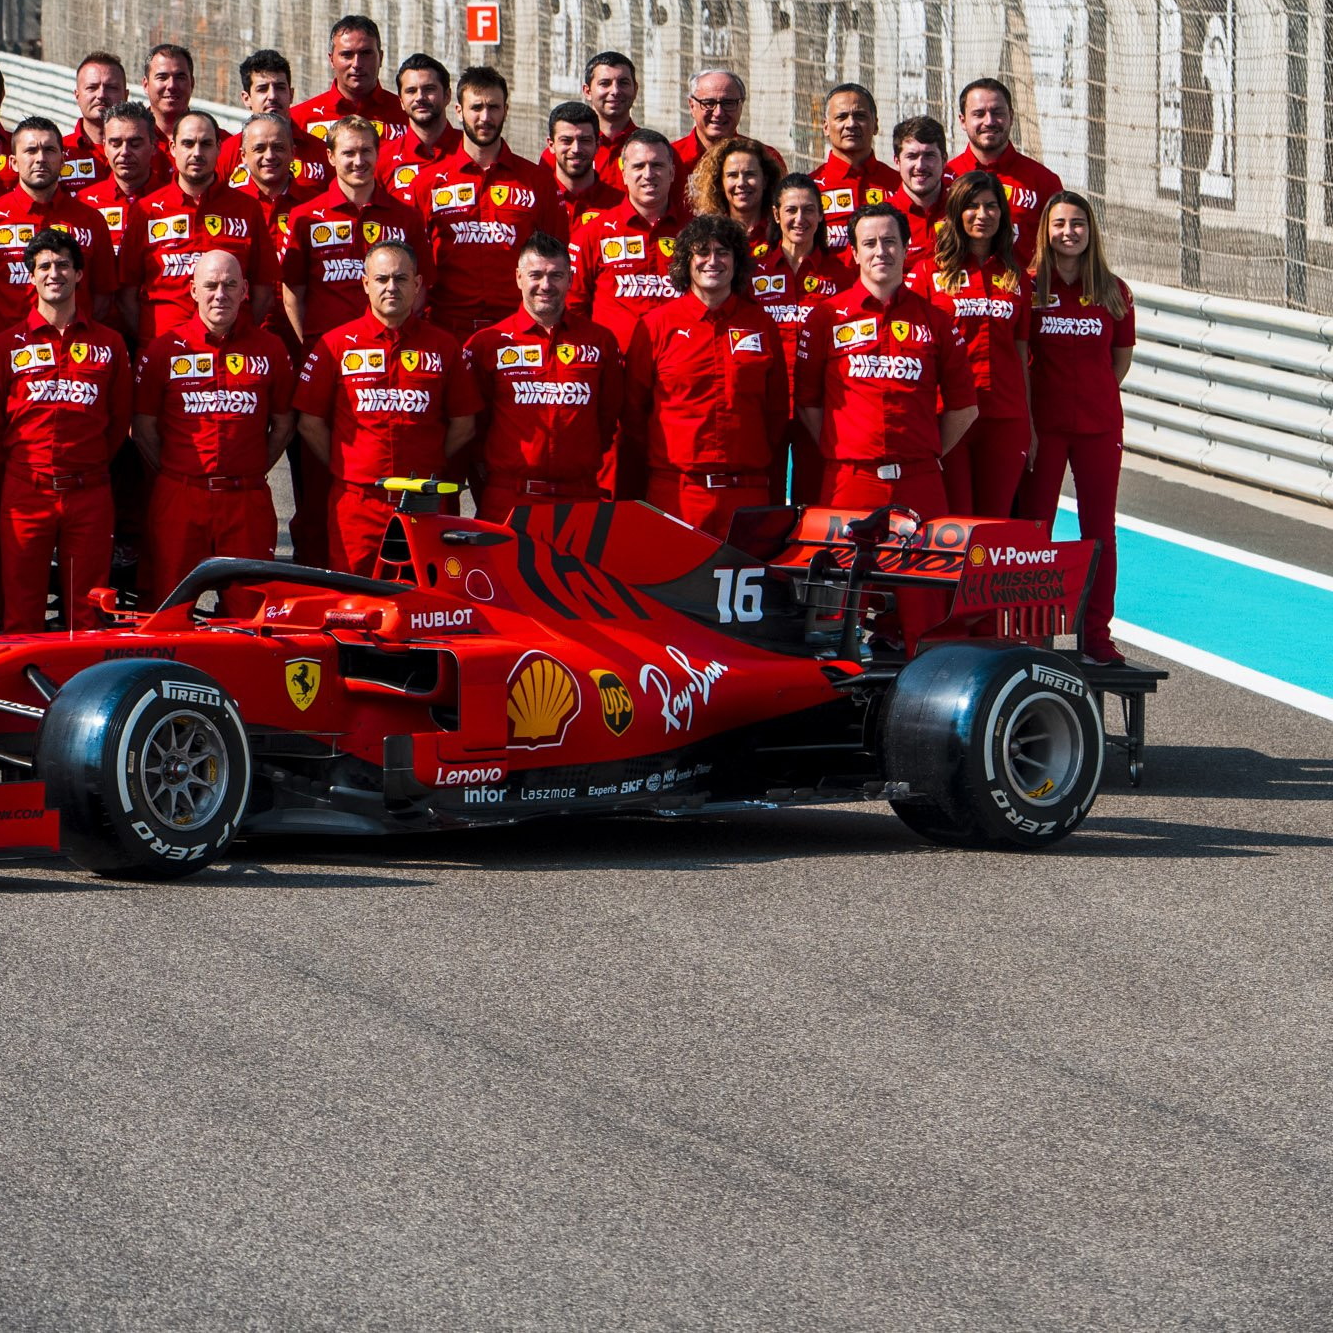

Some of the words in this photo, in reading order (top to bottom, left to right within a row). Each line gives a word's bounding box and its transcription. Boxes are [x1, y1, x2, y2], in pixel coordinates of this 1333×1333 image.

[476, 10, 491, 37] F
[458, 190, 472, 199] ups
[953, 298, 1013, 310] MISSION
[954, 307, 1013, 319] WINNOW
[1042, 316, 1102, 328] MISSION
[369, 355, 383, 365] ups
[525, 351, 540, 361] ups
[848, 355, 922, 369] MISSION
[848, 365, 922, 381] WINNOW
[26, 379, 98, 393] MISSION
[513, 382, 590, 394] MISSION
[27, 390, 97, 405] WINNOW
[182, 390, 257, 403] MISSION
[356, 388, 429, 402] MISSION
[514, 392, 590, 405] WINNOW
[184, 401, 256, 414] WINNOW
[356, 399, 429, 413] WINNOW
[989, 546, 1058, 566] V-Power
[990, 569, 1065, 588] MISSION
[713, 567, 765, 624] 16
[411, 608, 473, 629] HUBLOT
[1031, 664, 1084, 698] PIRELLI
[161, 680, 221, 706] PIRELLI
[601, 684, 632, 726] ups
[435, 767, 502, 786] Lenovo
[464, 785, 507, 803] infor
[588, 784, 617, 797] Experis
[620, 778, 644, 794] SKF
[989, 788, 1058, 836] ZERO
[131, 819, 208, 862] ZERO
